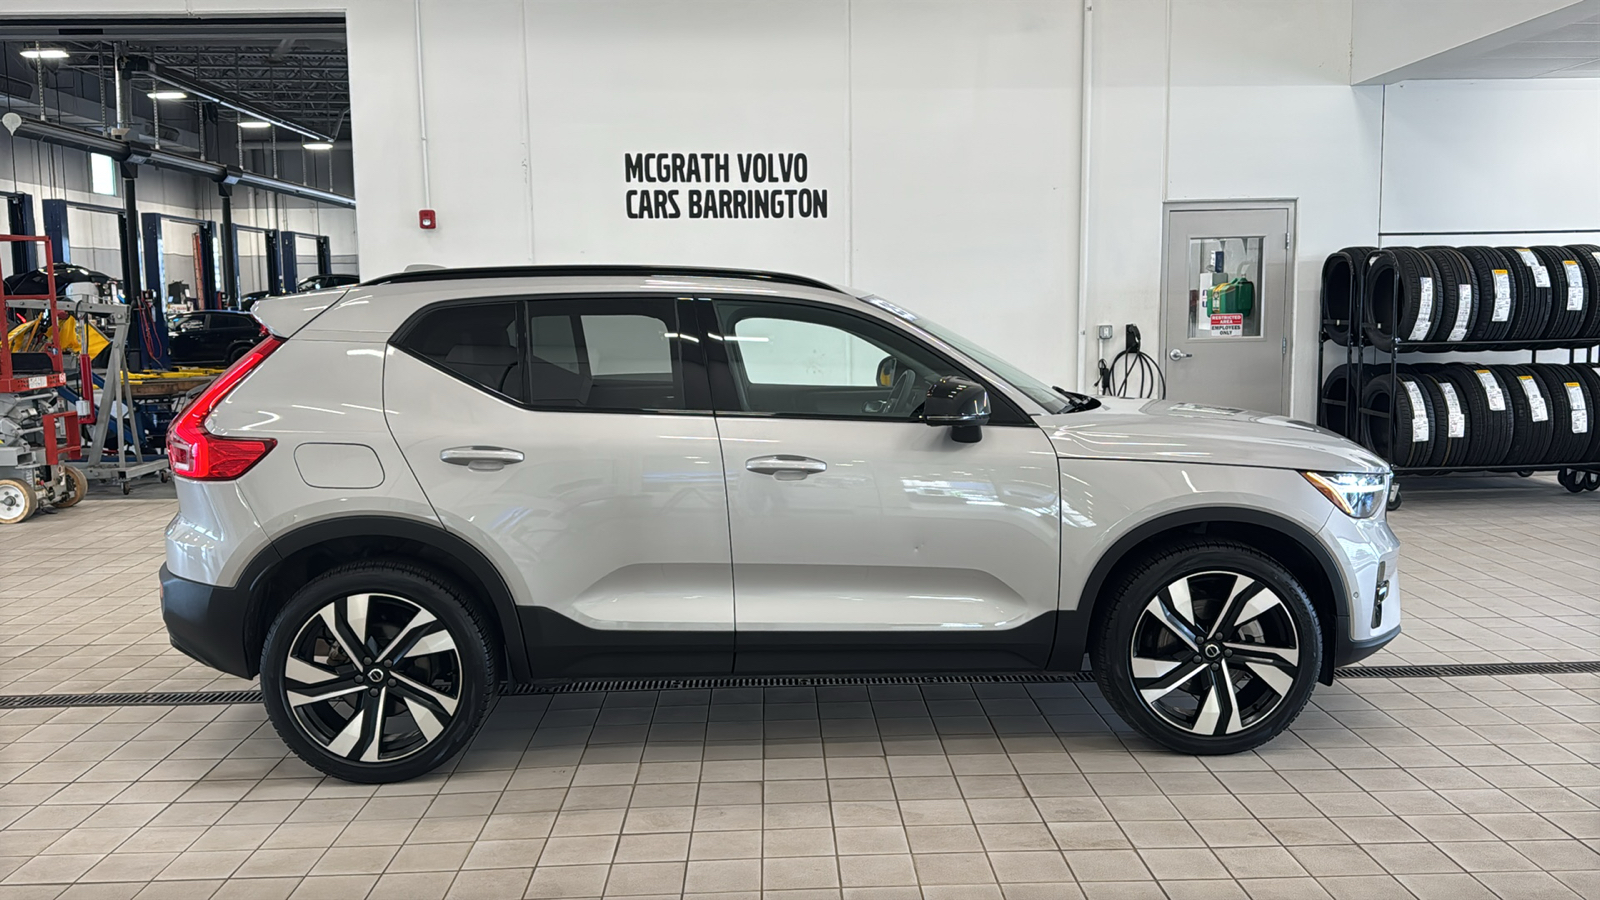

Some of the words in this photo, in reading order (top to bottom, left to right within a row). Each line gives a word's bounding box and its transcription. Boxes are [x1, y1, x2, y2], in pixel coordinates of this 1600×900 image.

[624, 153, 729, 182] MCGRATH
[737, 153, 807, 182] VOLVO
[626, 190, 681, 218] CARS
[688, 188, 828, 218] BARRINGTON
